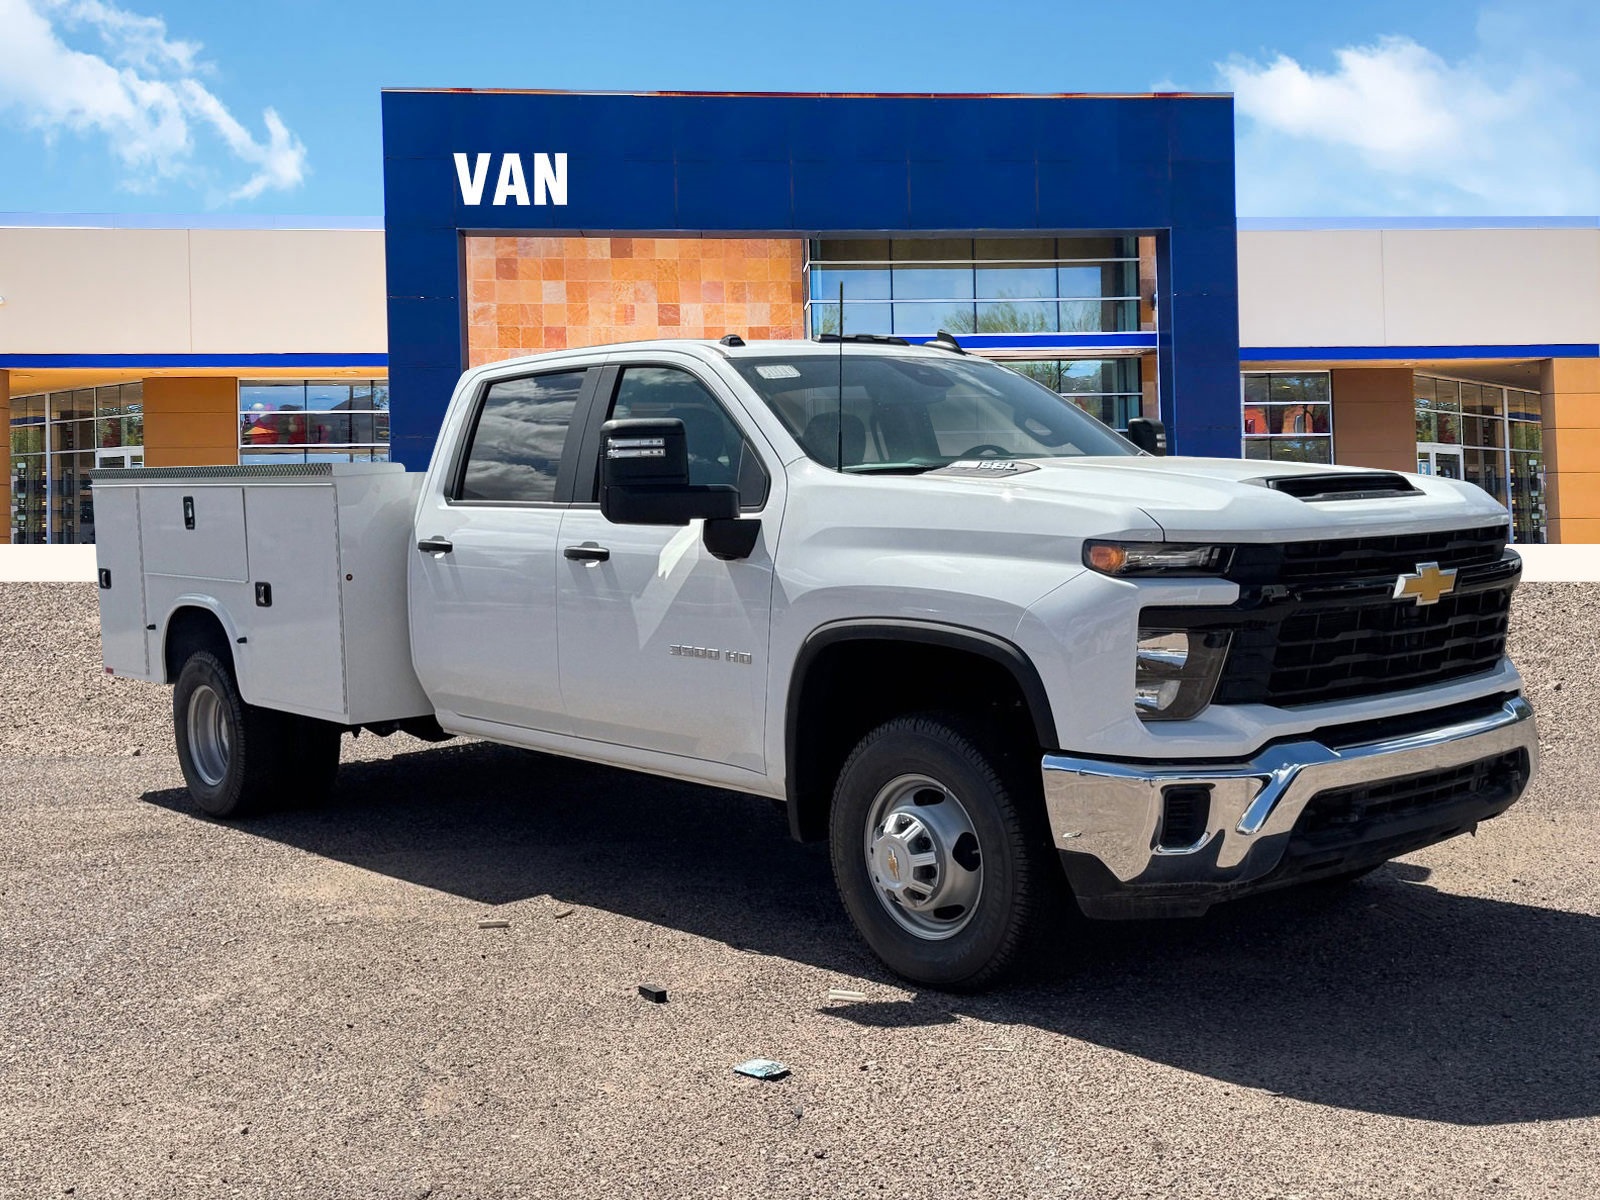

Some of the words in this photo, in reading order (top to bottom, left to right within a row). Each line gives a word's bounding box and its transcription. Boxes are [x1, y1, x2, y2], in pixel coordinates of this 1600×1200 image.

[453, 152, 568, 206] VAN
[669, 644, 720, 660] 3500
[725, 650, 752, 665] HD
